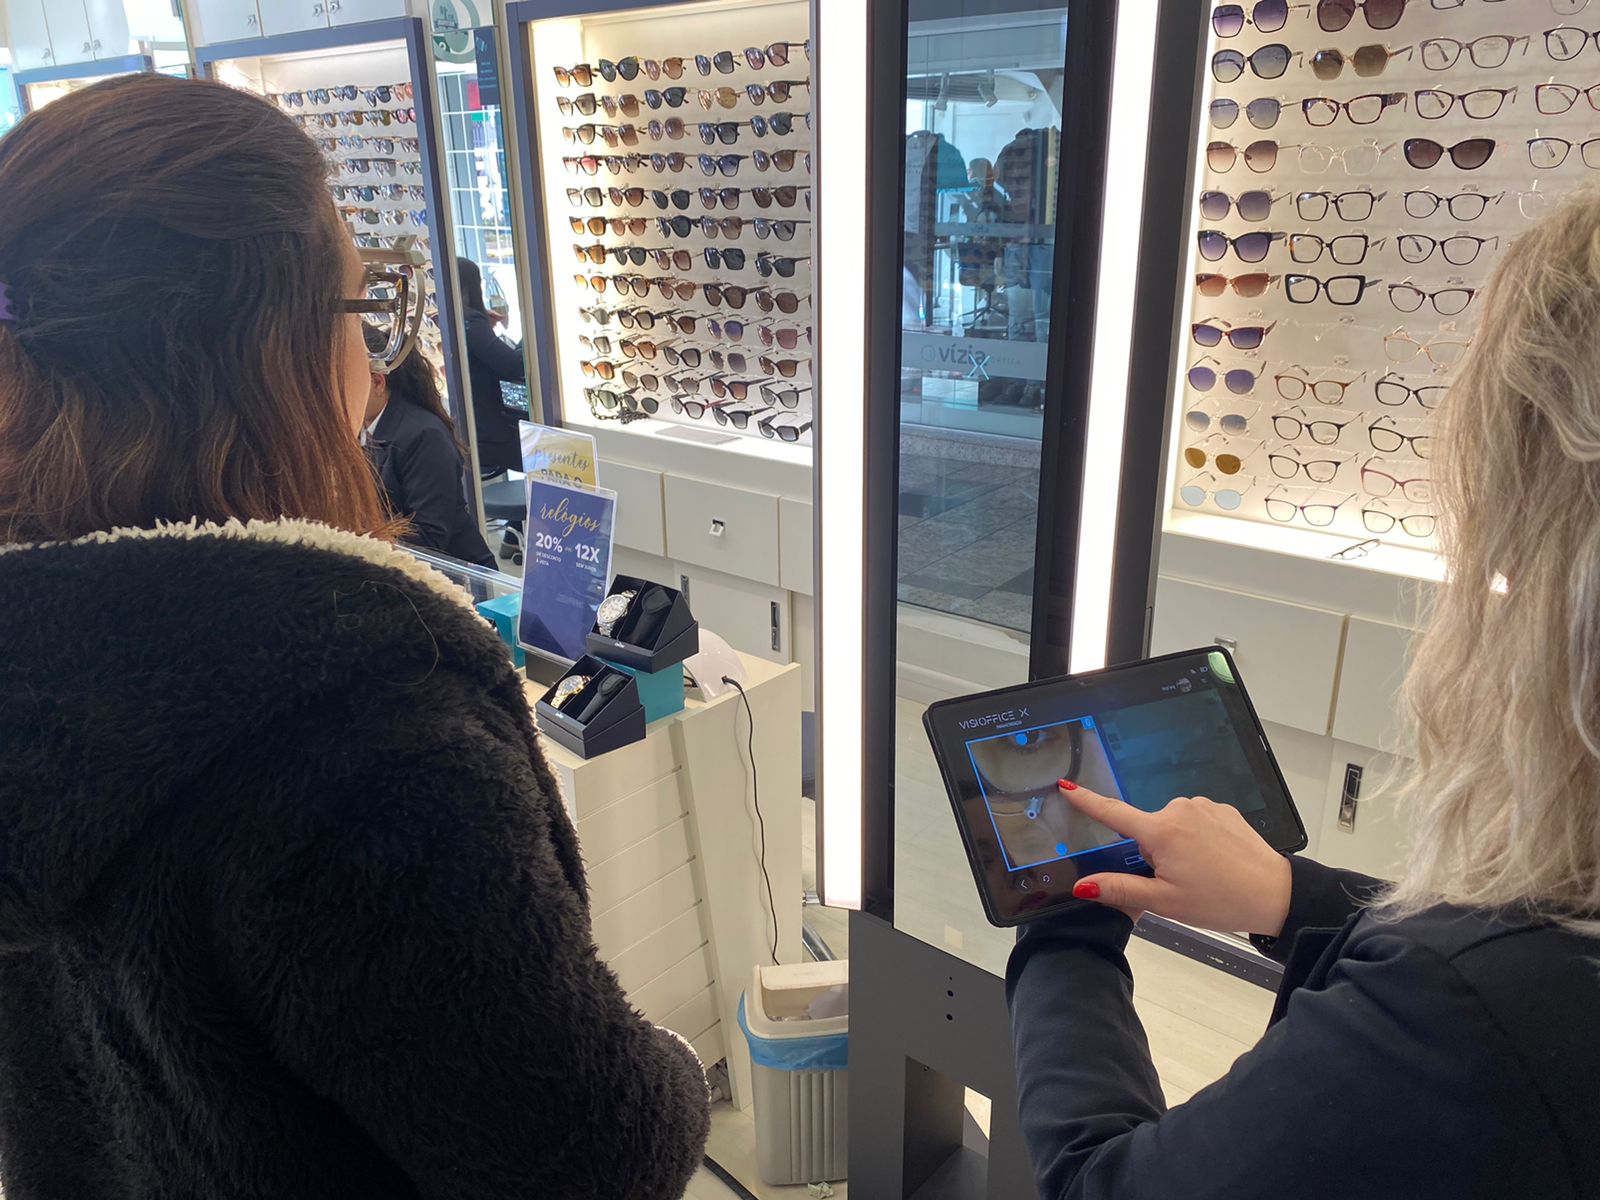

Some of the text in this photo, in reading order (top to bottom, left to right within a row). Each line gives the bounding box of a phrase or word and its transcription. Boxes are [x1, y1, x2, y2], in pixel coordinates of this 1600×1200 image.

[531, 448, 590, 472] presentes
[540, 498, 600, 537] relógios
[536, 532, 563, 553] 20%
[575, 543, 600, 564] 12X
[959, 710, 1015, 729] VISIOFFICE
[1018, 708, 1030, 718] X
